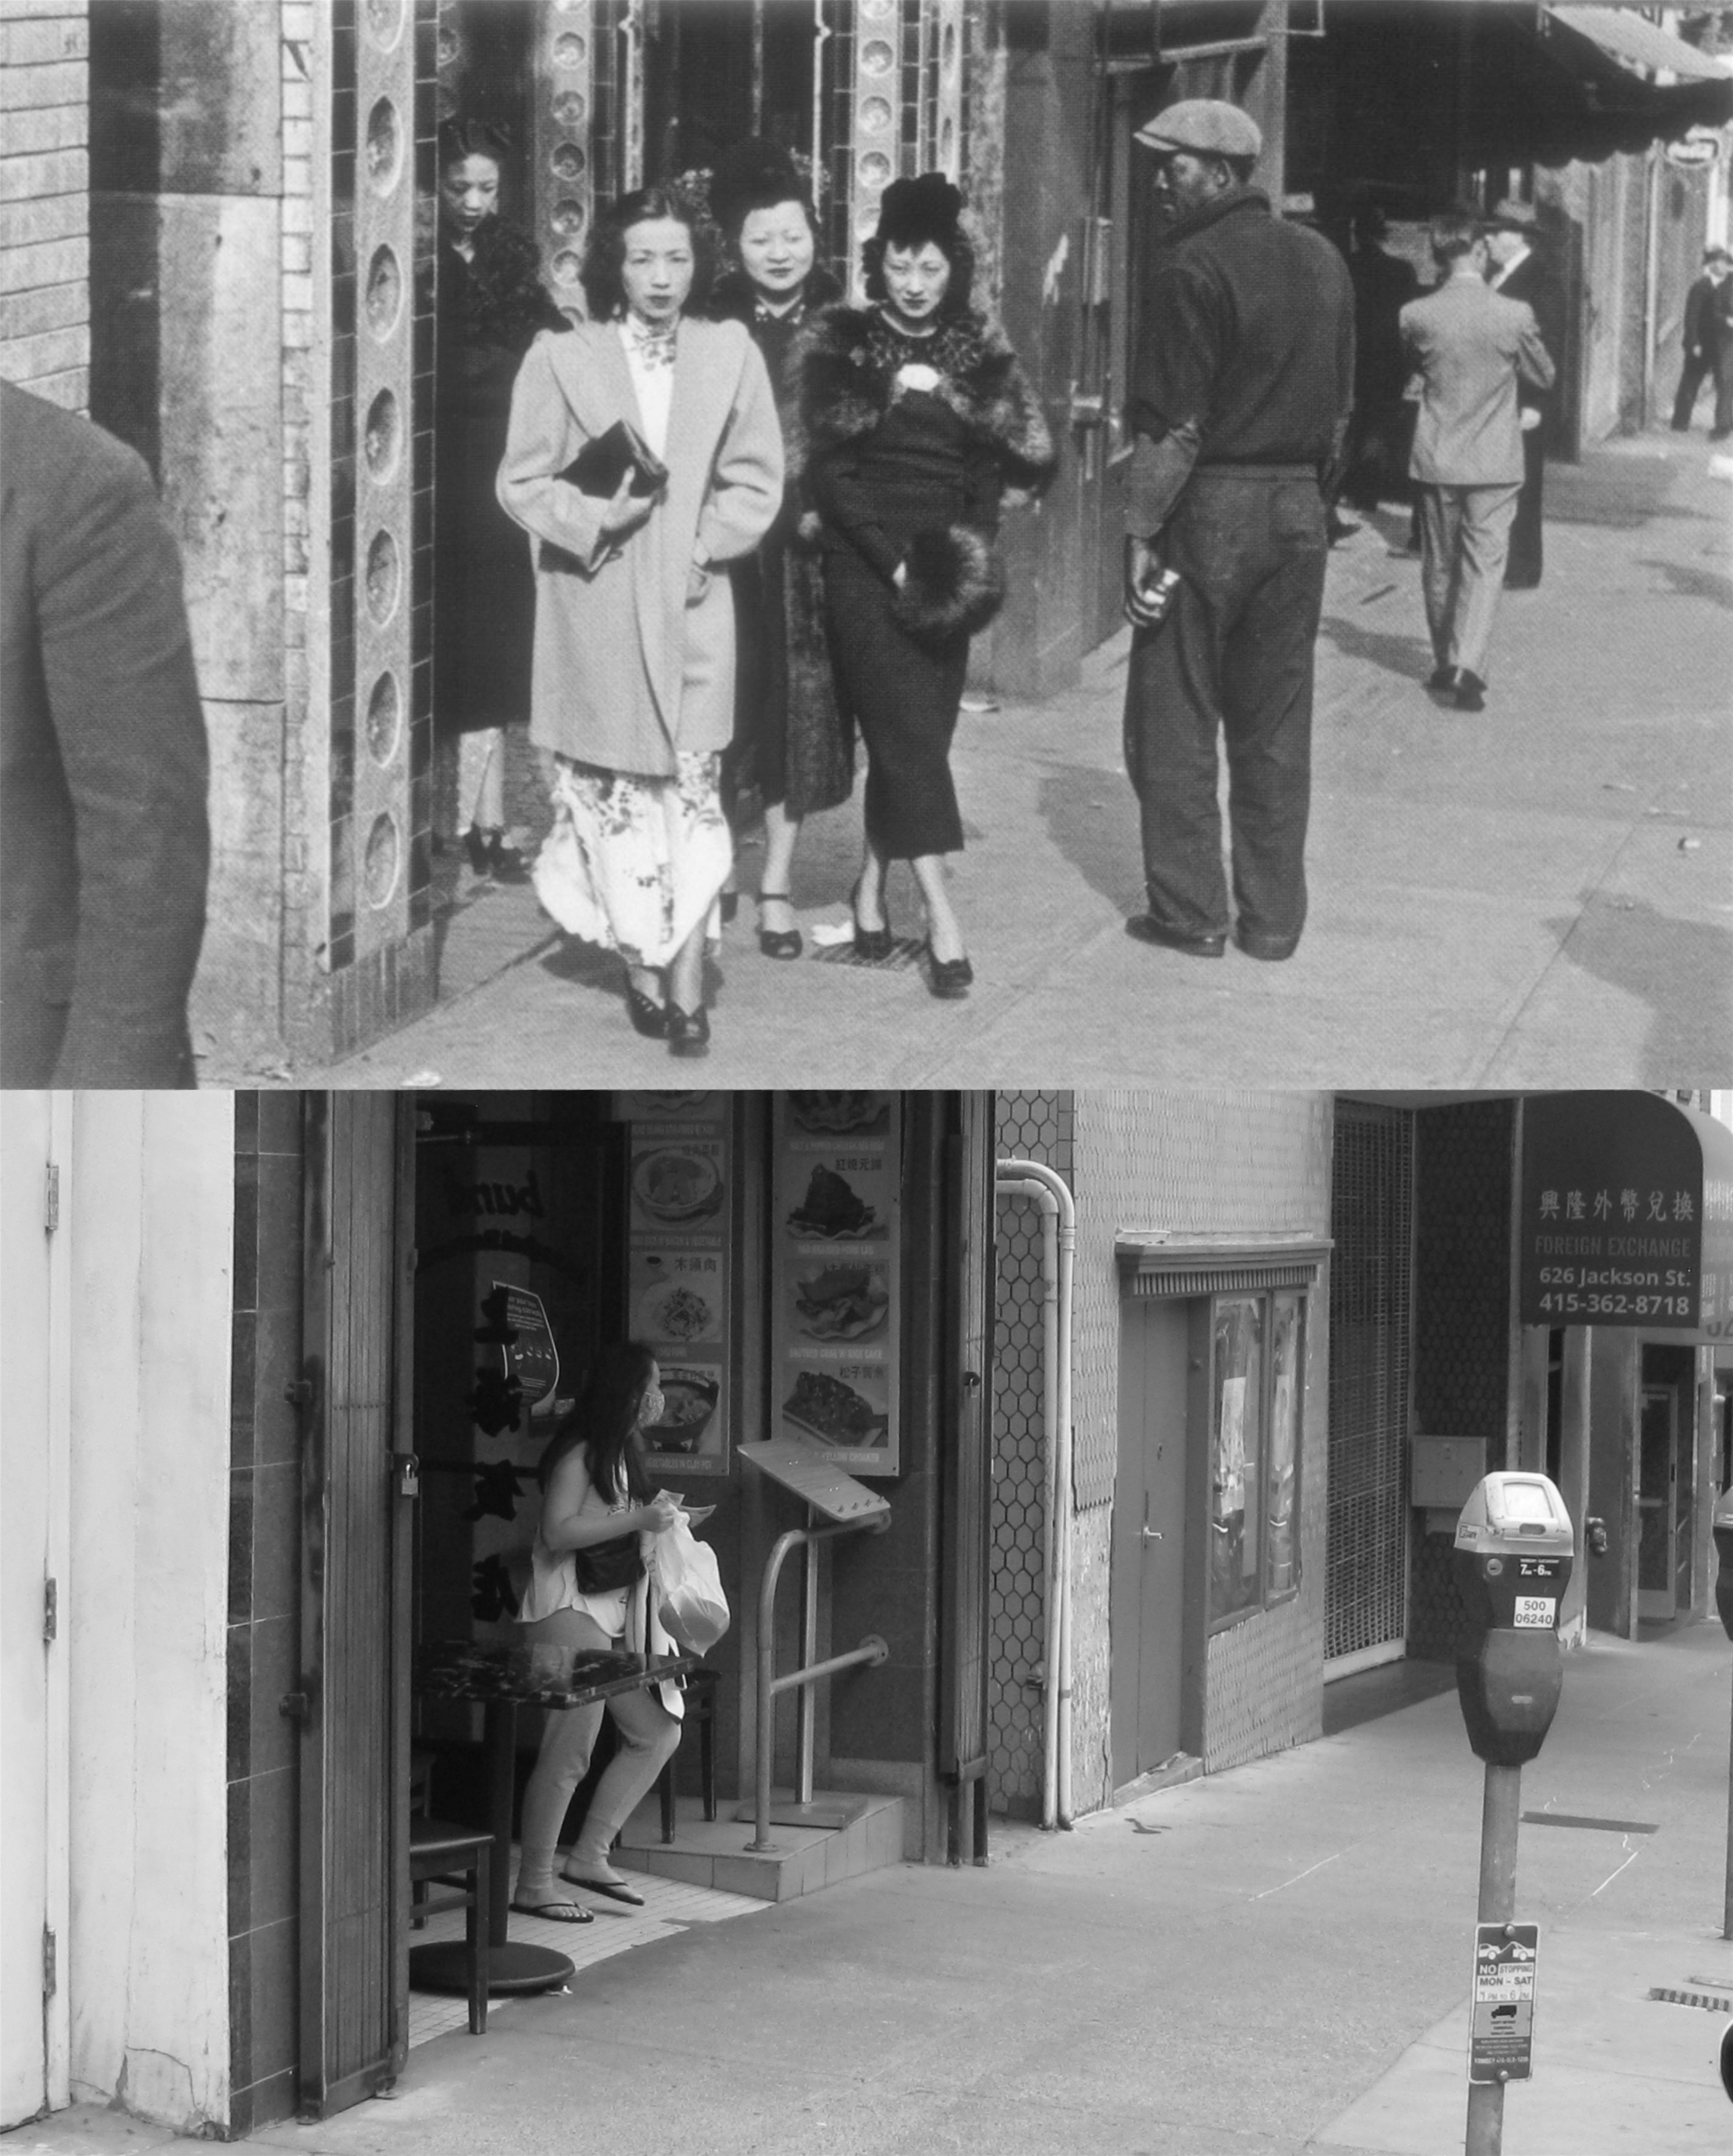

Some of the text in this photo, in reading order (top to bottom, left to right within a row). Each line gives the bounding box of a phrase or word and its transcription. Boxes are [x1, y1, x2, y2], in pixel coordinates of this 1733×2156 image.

[1536, 1235, 1691, 1257] FOREIGN EXCHANGE
[1539, 1267, 1574, 1284] 626
[1578, 1267, 1659, 1288] Jackson
[1665, 1270, 1691, 1287] St.
[1539, 1292, 1689, 1316] 415-362-8718
[1524, 1600, 1546, 1611] 500
[1516, 1614, 1553, 1625] 06240
[1479, 1964, 1533, 1974] NO STOPPING
[1480, 1977, 1503, 1986] MON
[1514, 1976, 1533, 1984] SAT
